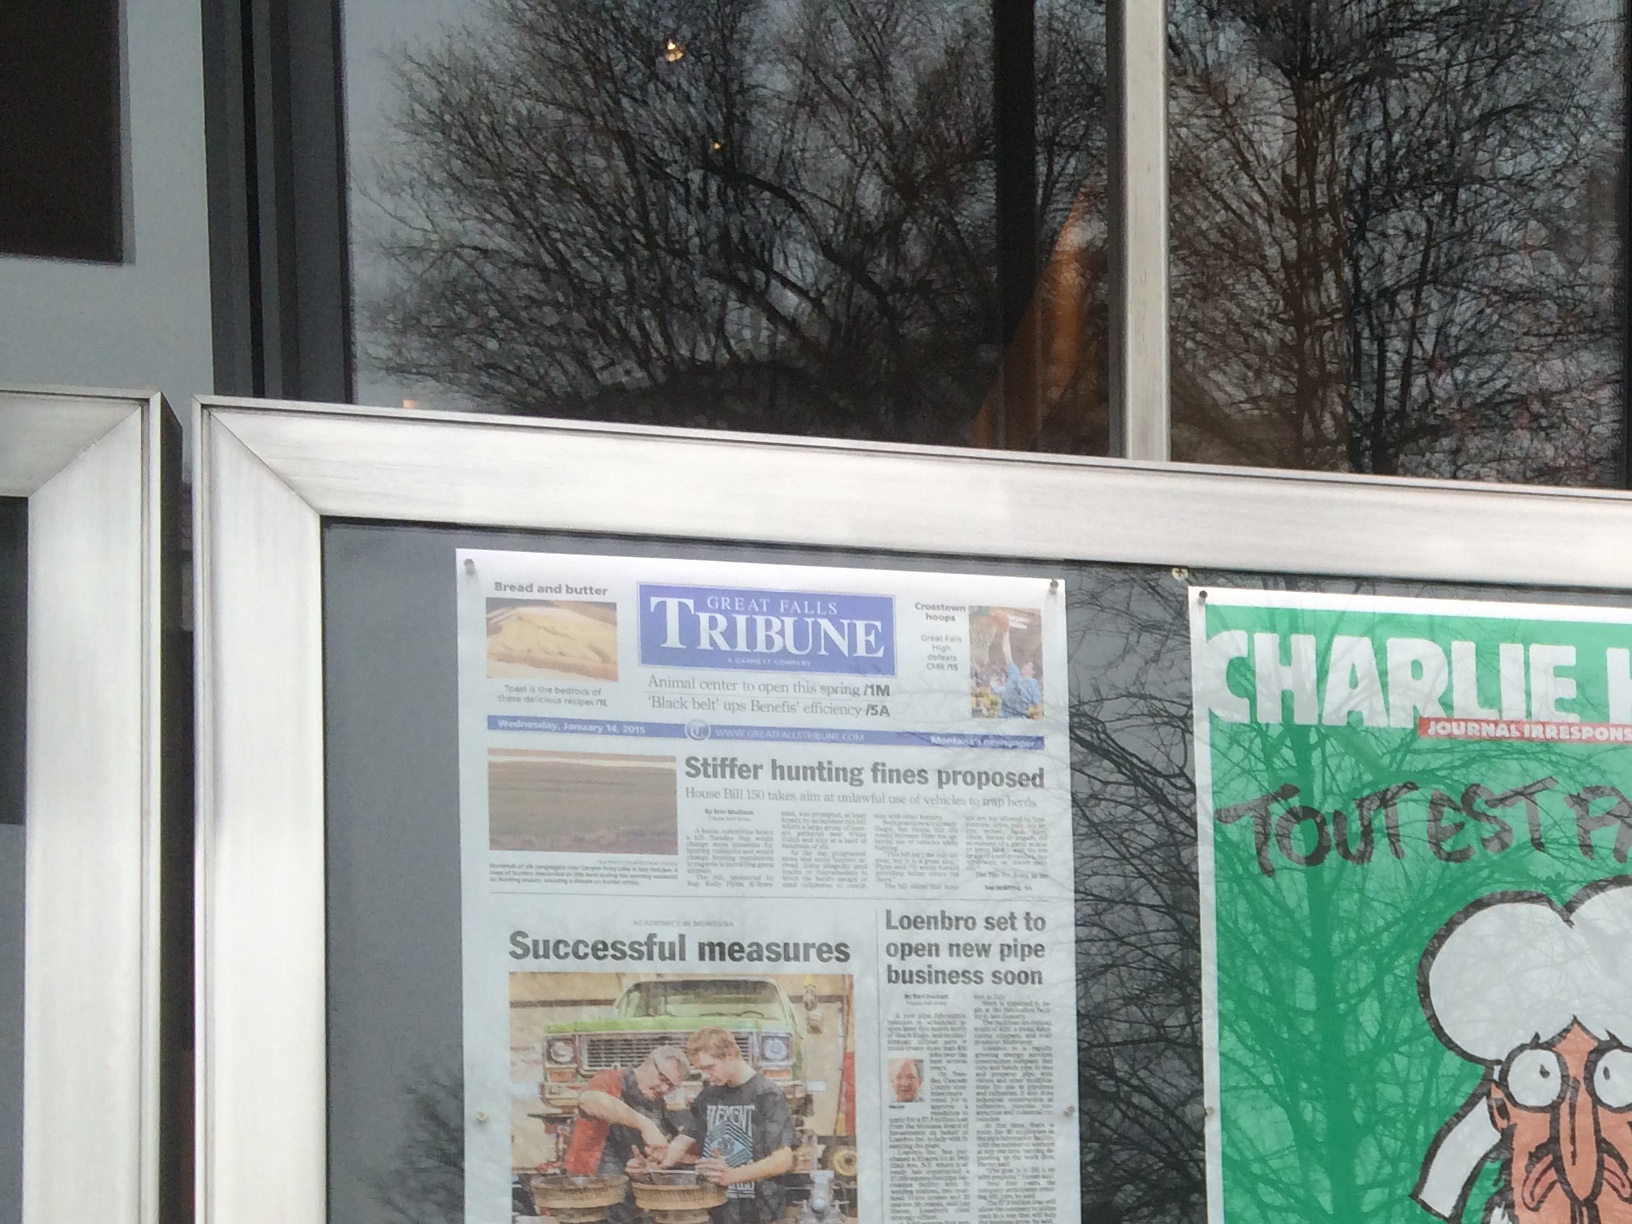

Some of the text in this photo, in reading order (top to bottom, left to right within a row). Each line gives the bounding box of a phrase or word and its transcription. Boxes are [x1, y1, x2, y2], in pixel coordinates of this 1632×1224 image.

[494, 582, 608, 595] Bread and butter
[707, 596, 837, 614] GREAT FALLS
[649, 596, 885, 658] TRIBUNE
[648, 674, 695, 689] Animal
[699, 680, 738, 691] center
[743, 681, 755, 691] to
[758, 683, 789, 695] open
[793, 681, 816, 693] this
[820, 682, 860, 697] spring
[1204, 629, 1581, 728] CHARLIE
[1428, 721, 1520, 737] JOURNAL
[685, 756, 1045, 789] Stiffer hunting fines proposed
[1213, 781, 1419, 878] TOUT
[1427, 775, 1558, 864] EST
[886, 910, 1046, 931] Loenbro set to
[509, 931, 851, 962] Successful measures
[886, 939, 1045, 962] open new pipe
[887, 964, 1043, 985] business soon
